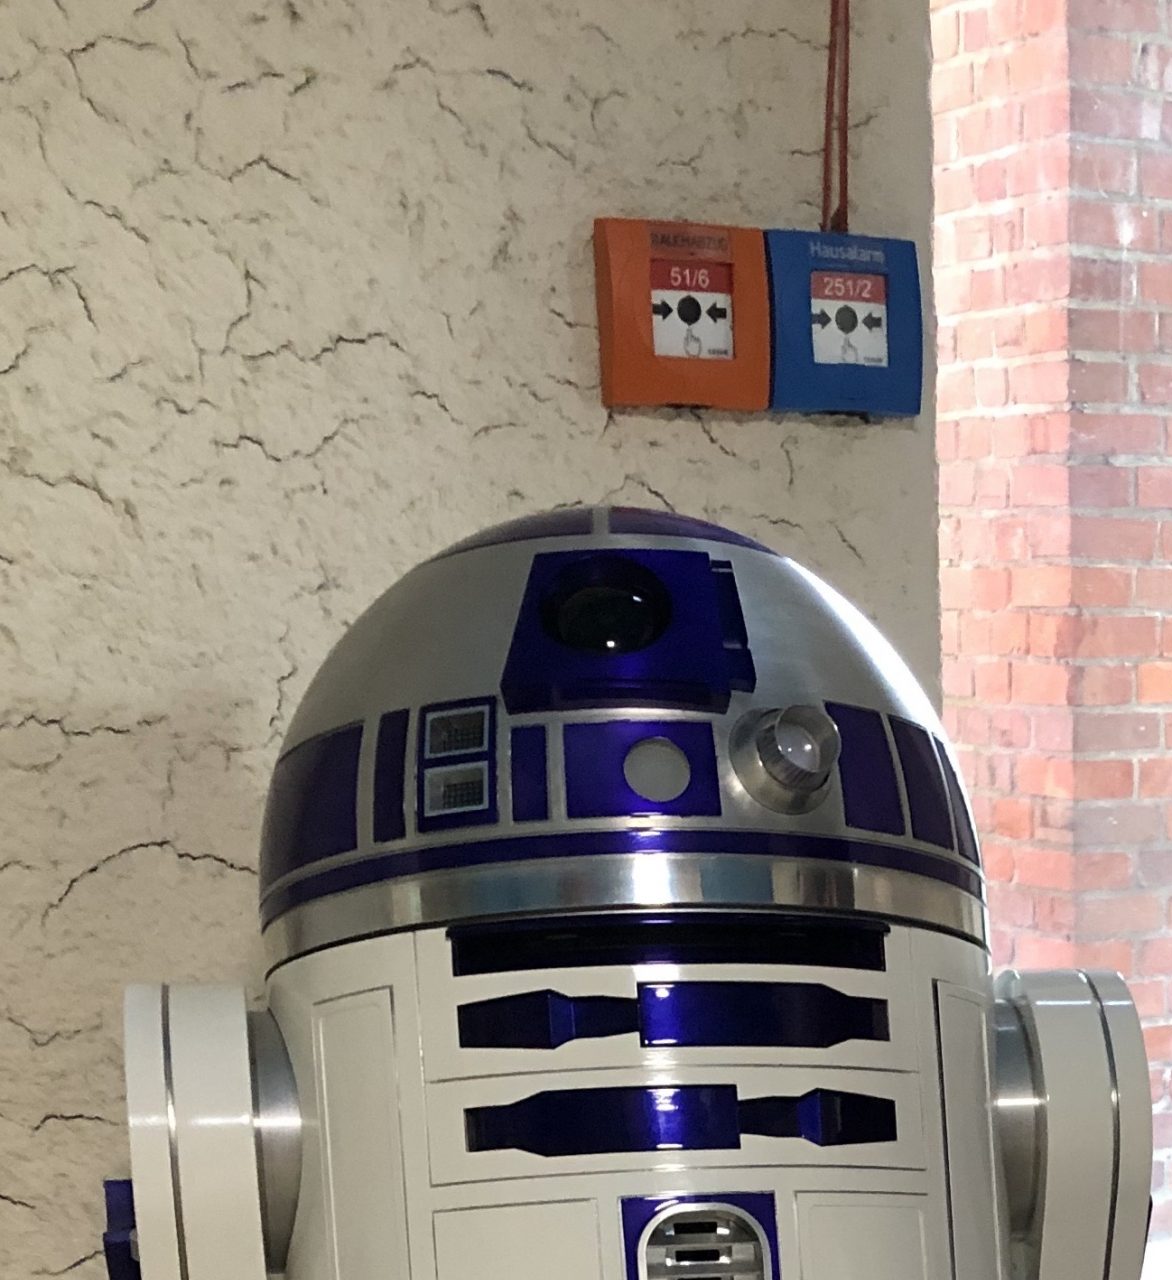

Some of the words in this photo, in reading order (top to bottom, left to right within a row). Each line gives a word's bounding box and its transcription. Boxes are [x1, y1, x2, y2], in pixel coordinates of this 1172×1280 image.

[809, 241, 886, 264] Hausalarm
[670, 266, 710, 289] 51/6
[823, 276, 872, 298] 251/2
